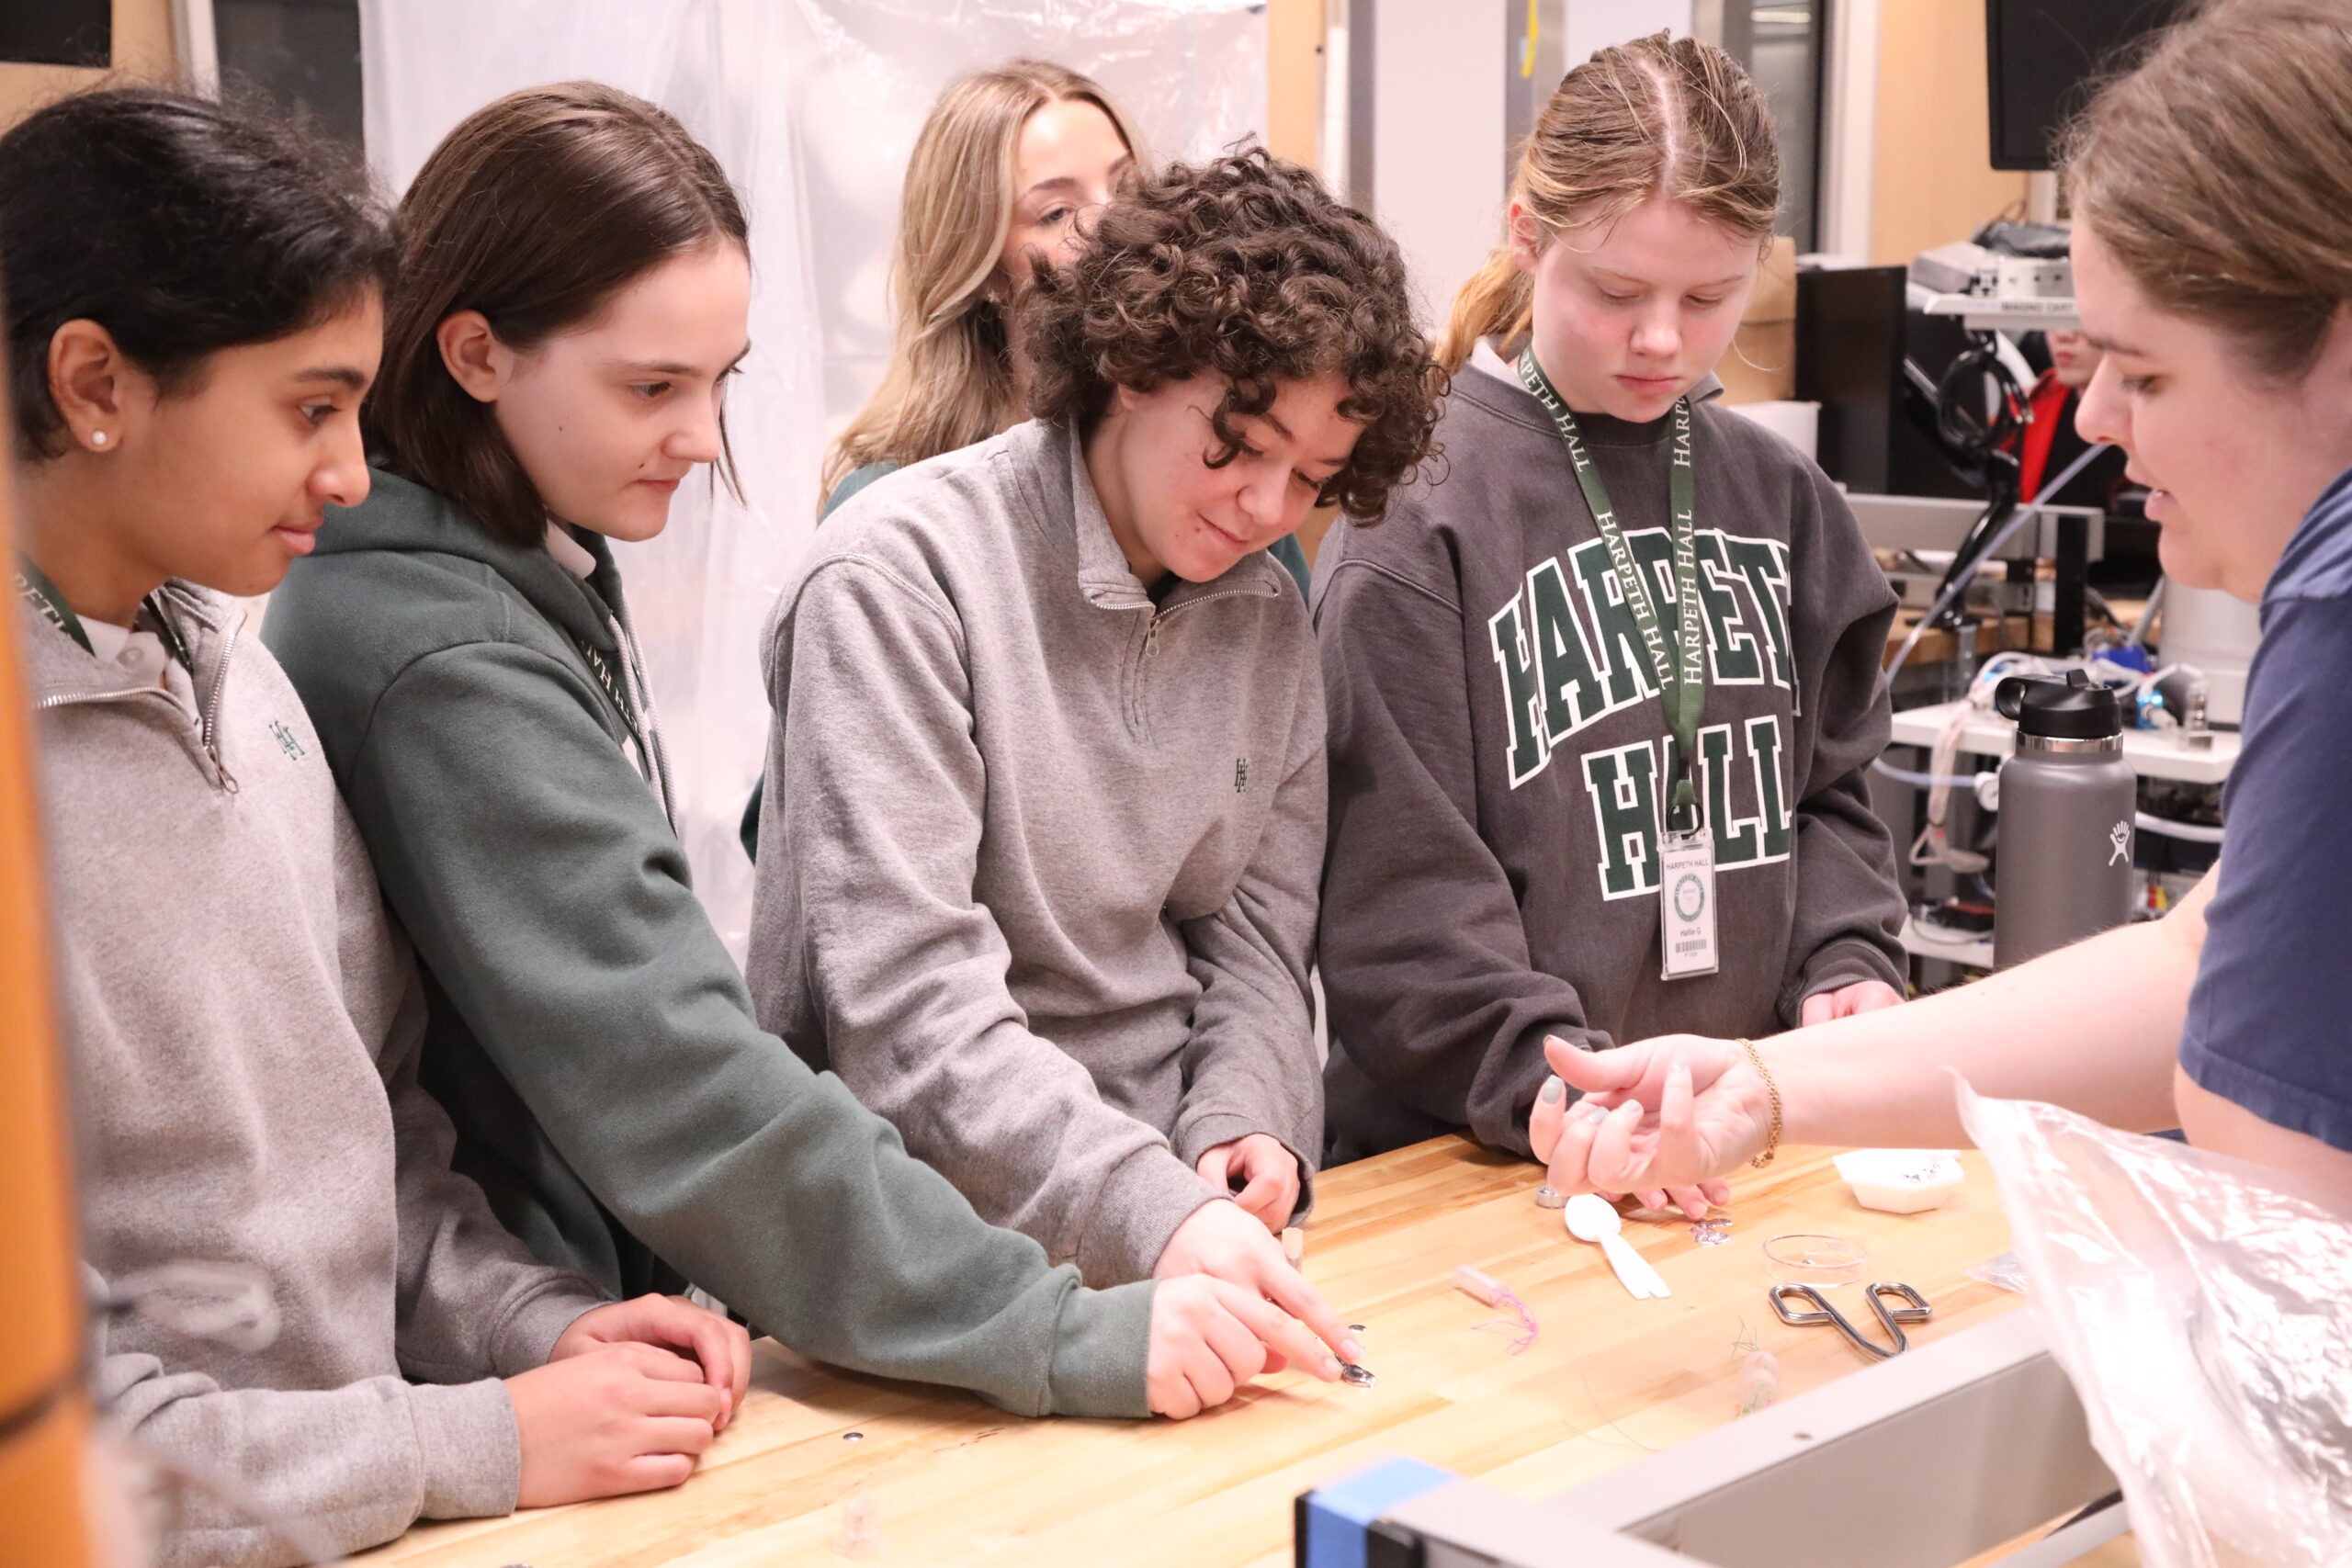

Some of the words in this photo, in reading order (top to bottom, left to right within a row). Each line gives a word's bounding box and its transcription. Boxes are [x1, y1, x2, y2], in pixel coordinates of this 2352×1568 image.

[1555, 412, 1590, 472] HALL
[1674, 395, 1691, 468] HARP
[1677, 509, 1696, 569] HALL
[1597, 510, 1651, 622] HARPETH
[1642, 625, 1675, 690] HALL
[1680, 577, 1703, 685] HARPETH
[1666, 860, 1693, 870] HARPETH
[1694, 858, 1710, 867] HALL
